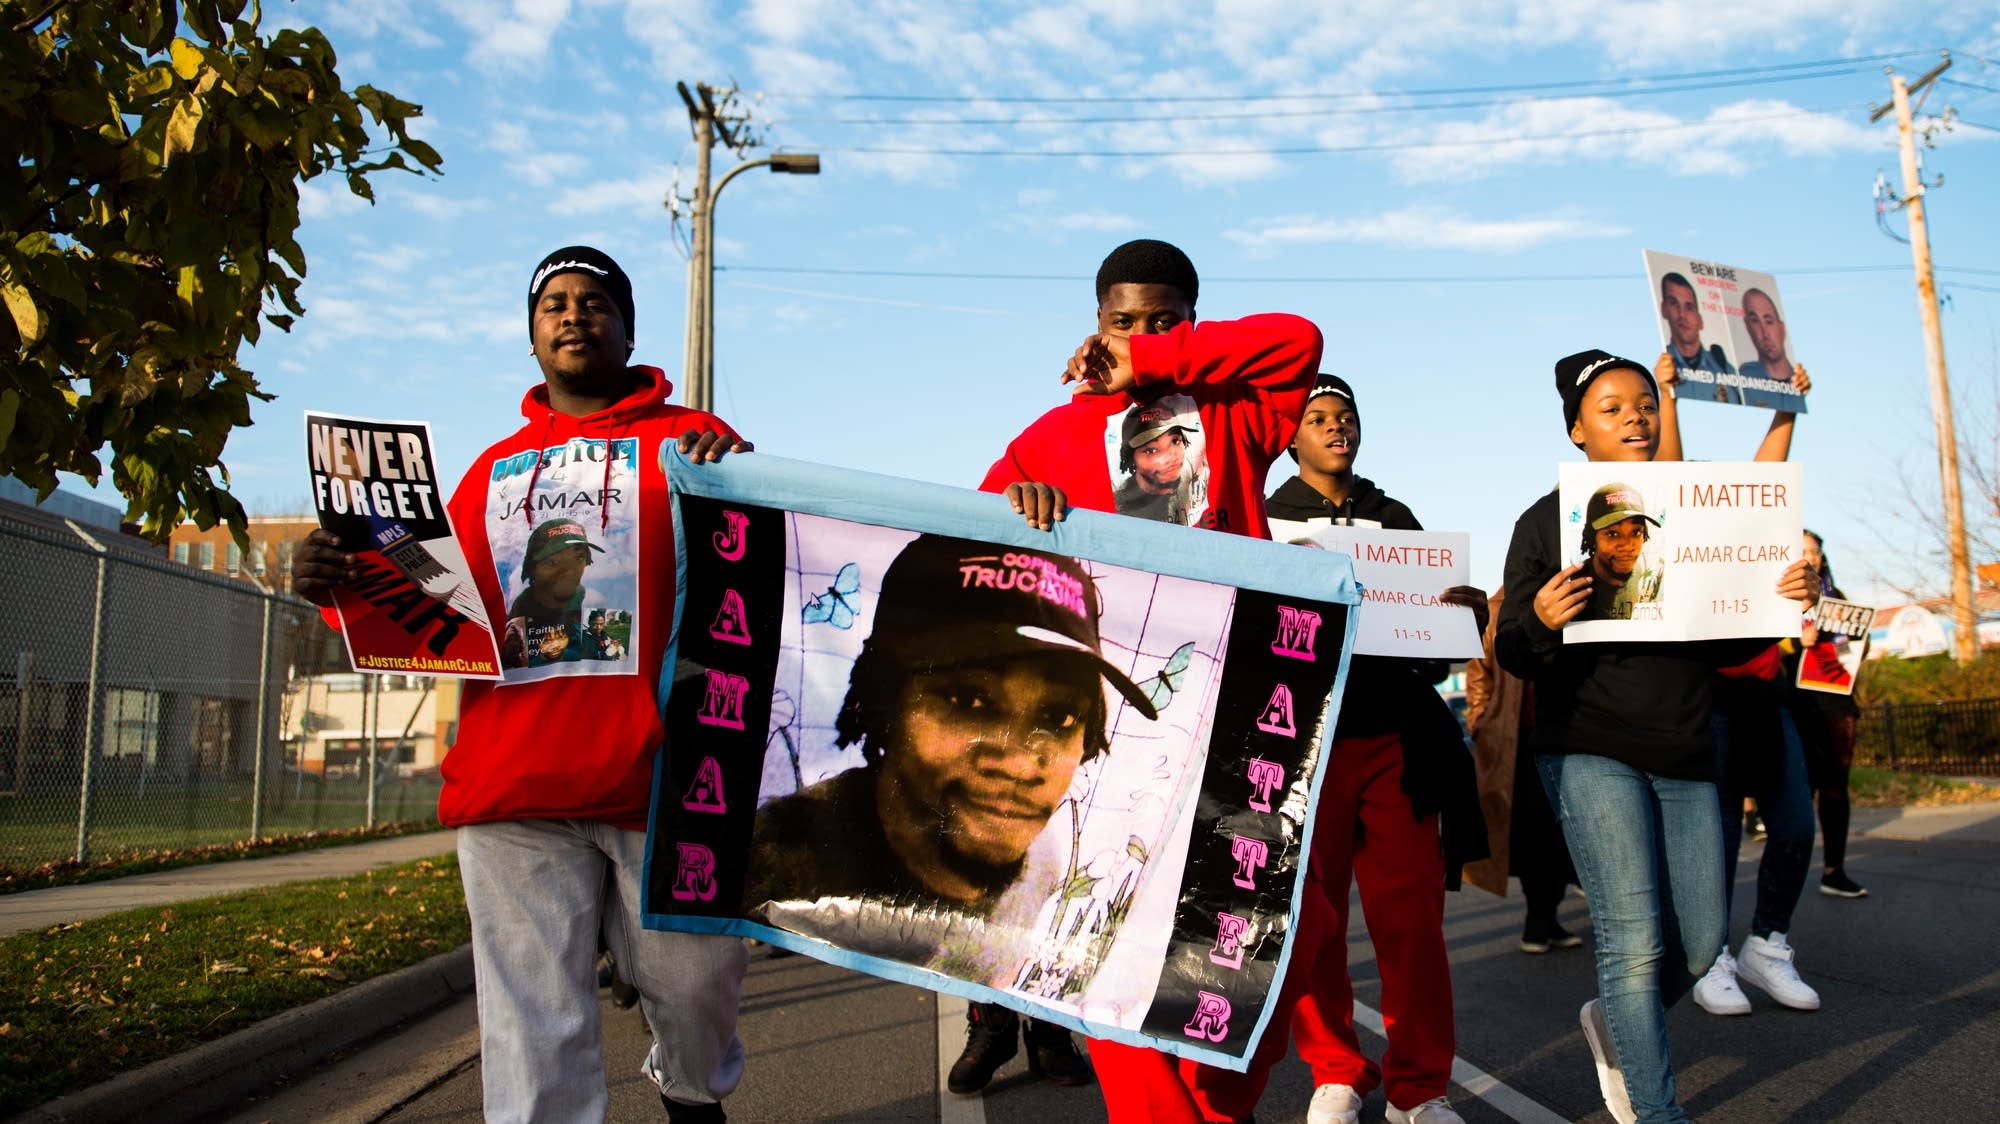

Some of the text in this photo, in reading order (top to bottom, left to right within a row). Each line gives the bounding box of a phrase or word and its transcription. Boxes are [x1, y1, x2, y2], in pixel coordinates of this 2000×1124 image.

[1690, 261, 1737, 281] BEWARE
[1716, 372, 1739, 388] AND
[311, 423, 430, 481] NEVER
[496, 440, 632, 482] JUSTICE
[551, 470, 567, 482] 4
[315, 474, 435, 520] FORGET
[500, 488, 622, 521] JAMAR
[1679, 484, 1787, 508] I MATTER
[376, 524, 406, 546] MPLS
[404, 552, 432, 572] POLICE
[1354, 543, 1454, 568] I MATTER
[1673, 545, 1791, 564] JAMAR CLARK
[1362, 588, 1406, 604] AMAR
[1712, 599, 1749, 615] 11-15
[1820, 602, 1873, 624] NEVER
[528, 625, 554, 635] Faith
[1393, 628, 1432, 641] 11-15
[1816, 615, 1866, 637] FORGET
[528, 638, 545, 646] my
[672, 510, 752, 901] JAMAR
[1184, 604, 1323, 1044] MATTER
